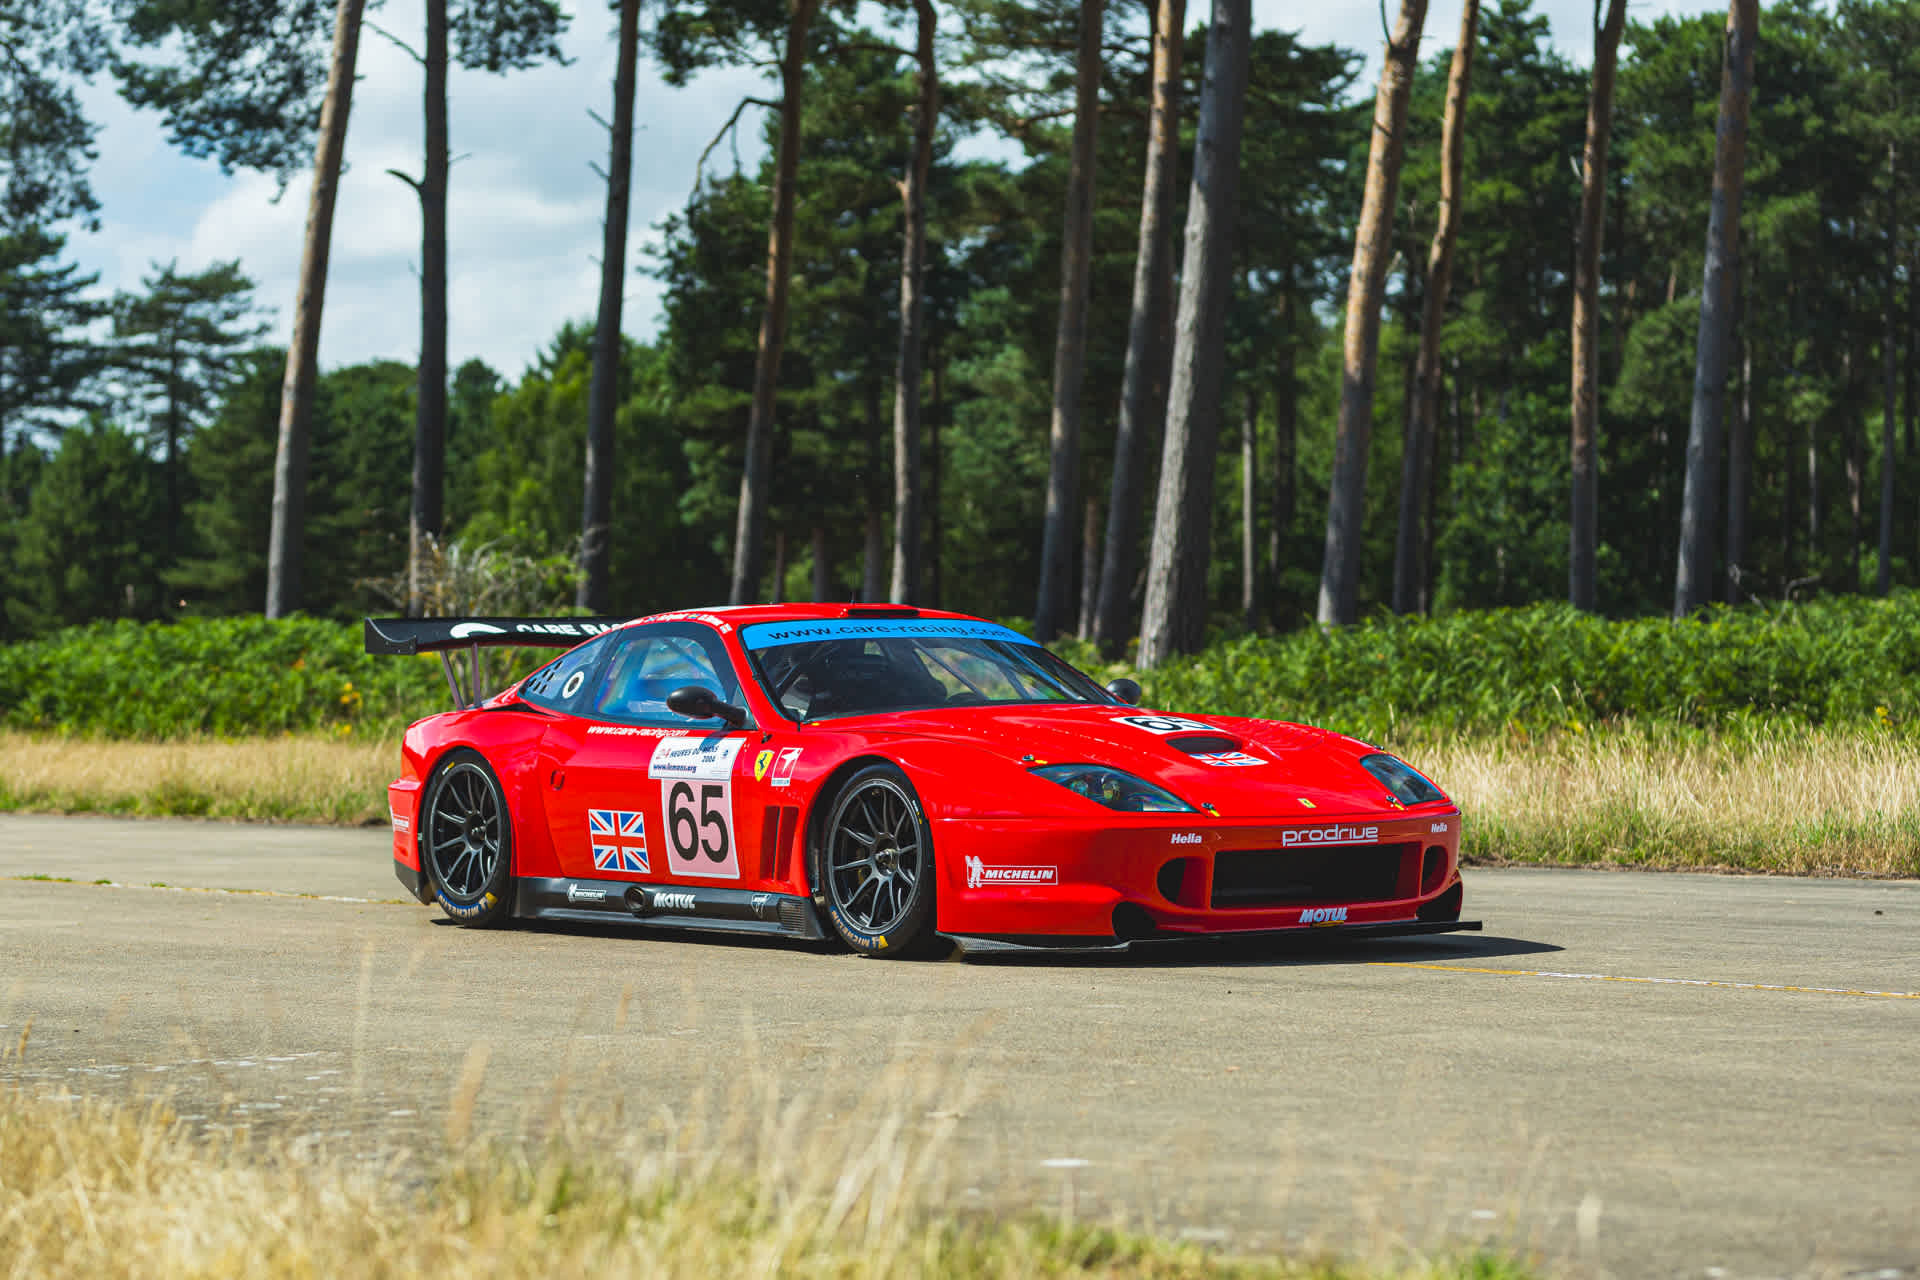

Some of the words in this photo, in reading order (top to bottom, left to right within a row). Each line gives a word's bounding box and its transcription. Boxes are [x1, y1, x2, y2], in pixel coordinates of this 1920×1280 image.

[516, 624, 582, 636] CARE
[767, 625, 1017, 641] www.care-racing.com
[1123, 715, 1216, 731] 65
[587, 725, 689, 739] www.care-racing.com
[653, 763, 697, 774] www.lemans.org
[668, 781, 730, 864] 65
[1431, 822, 1448, 833] Hella
[1171, 832, 1202, 844] Hella
[1282, 824, 1379, 847] prodrive
[984, 869, 1055, 880] MICHELIN
[653, 892, 696, 910] MOTUL
[1299, 907, 1348, 923] MOTUL
[830, 910, 871, 948] MICHELIN
